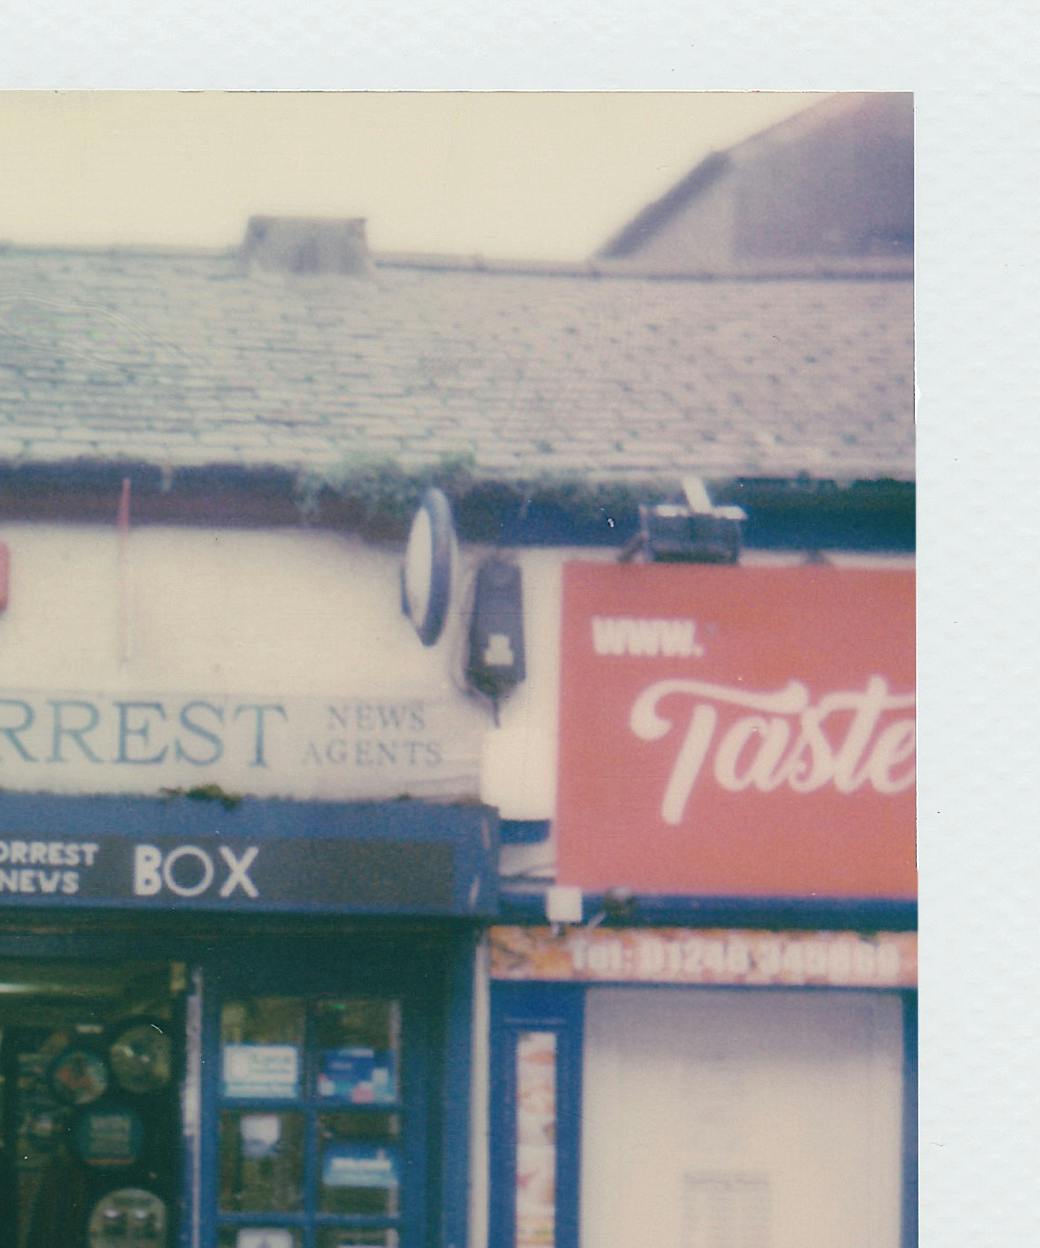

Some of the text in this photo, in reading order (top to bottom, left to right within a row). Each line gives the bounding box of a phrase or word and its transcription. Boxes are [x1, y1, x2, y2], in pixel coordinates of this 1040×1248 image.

[328, 704, 425, 731] NEWS
[305, 737, 442, 767] AGENTS
[133, 844, 260, 897] BOX
